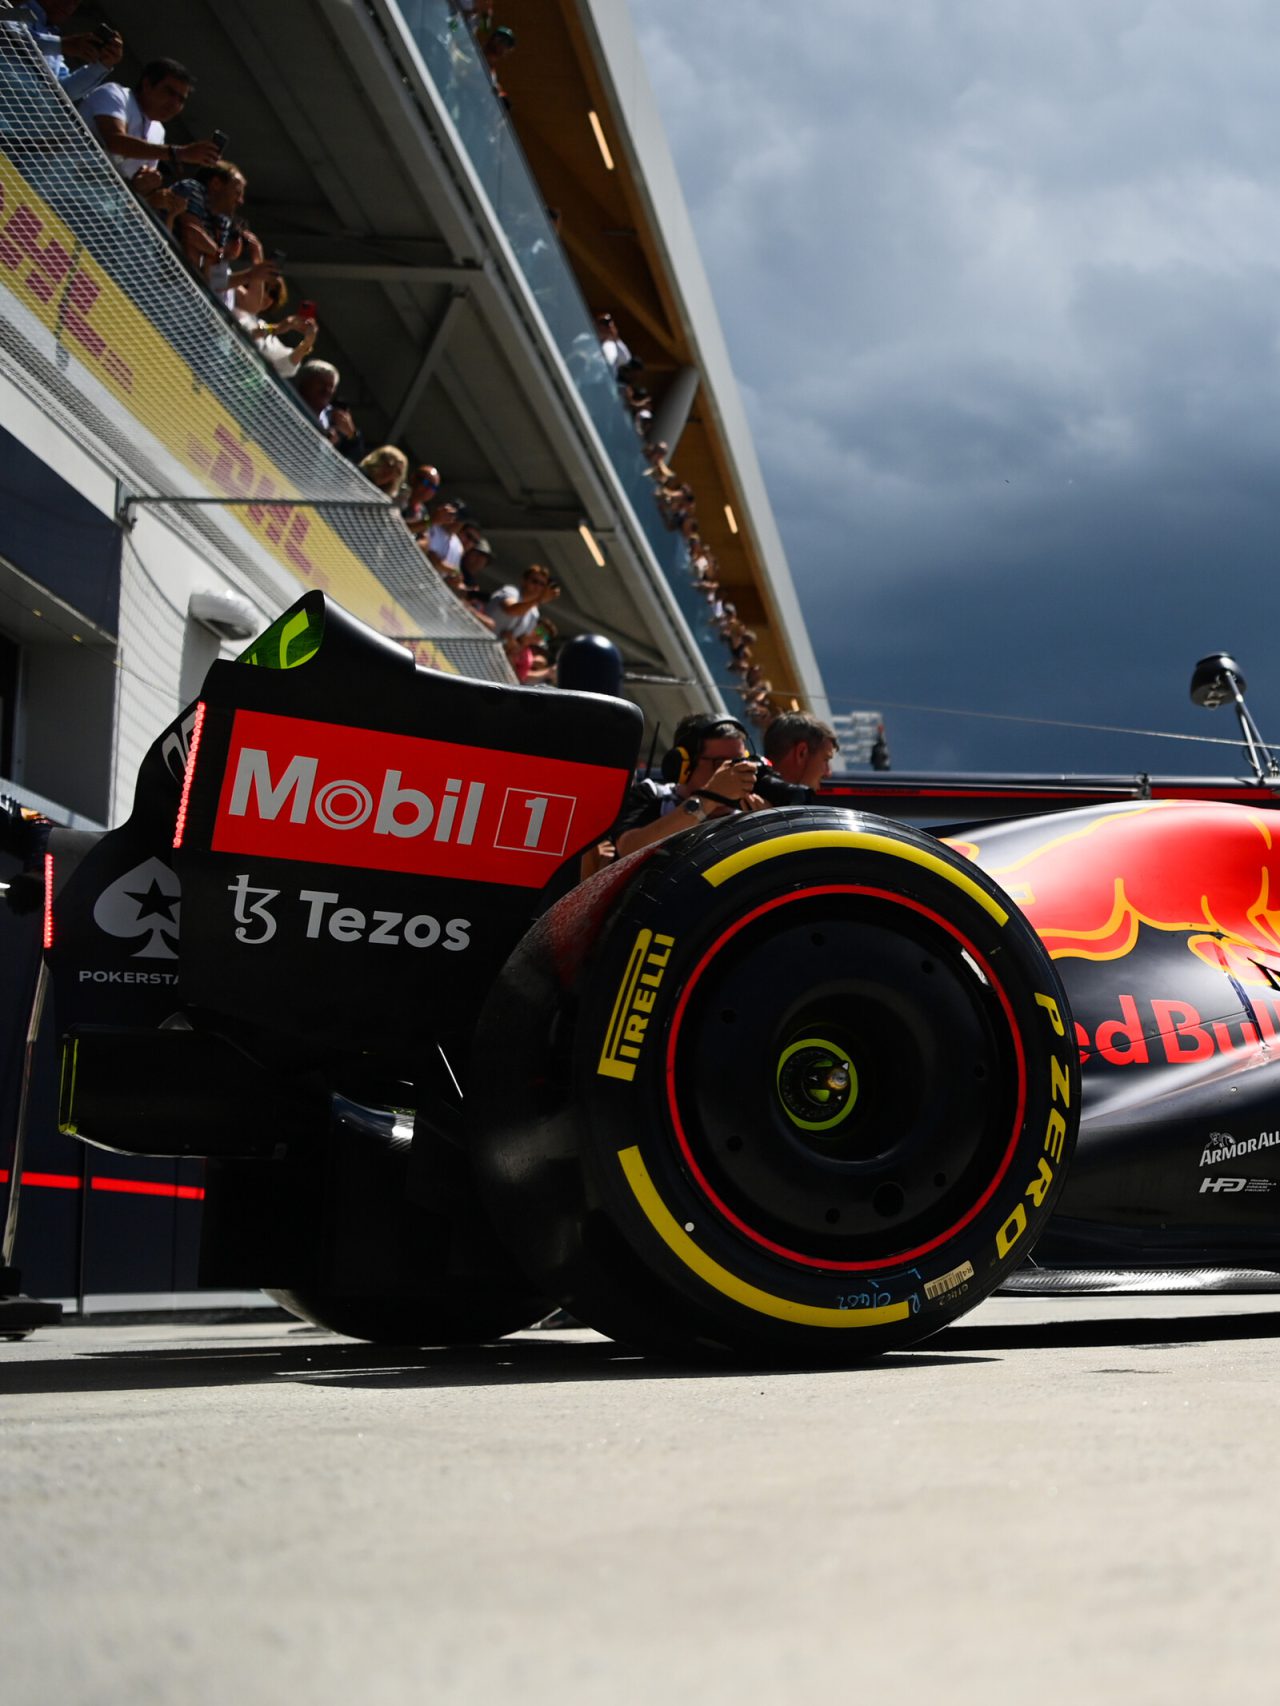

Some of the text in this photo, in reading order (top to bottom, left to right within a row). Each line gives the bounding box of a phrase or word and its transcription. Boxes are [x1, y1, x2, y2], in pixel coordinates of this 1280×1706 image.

[228, 747, 486, 846] Mobil
[525, 797, 549, 848] 1
[299, 889, 472, 952] Tezos
[597, 928, 676, 1082] PIRELLI
[995, 991, 1071, 1261] P ZERO
